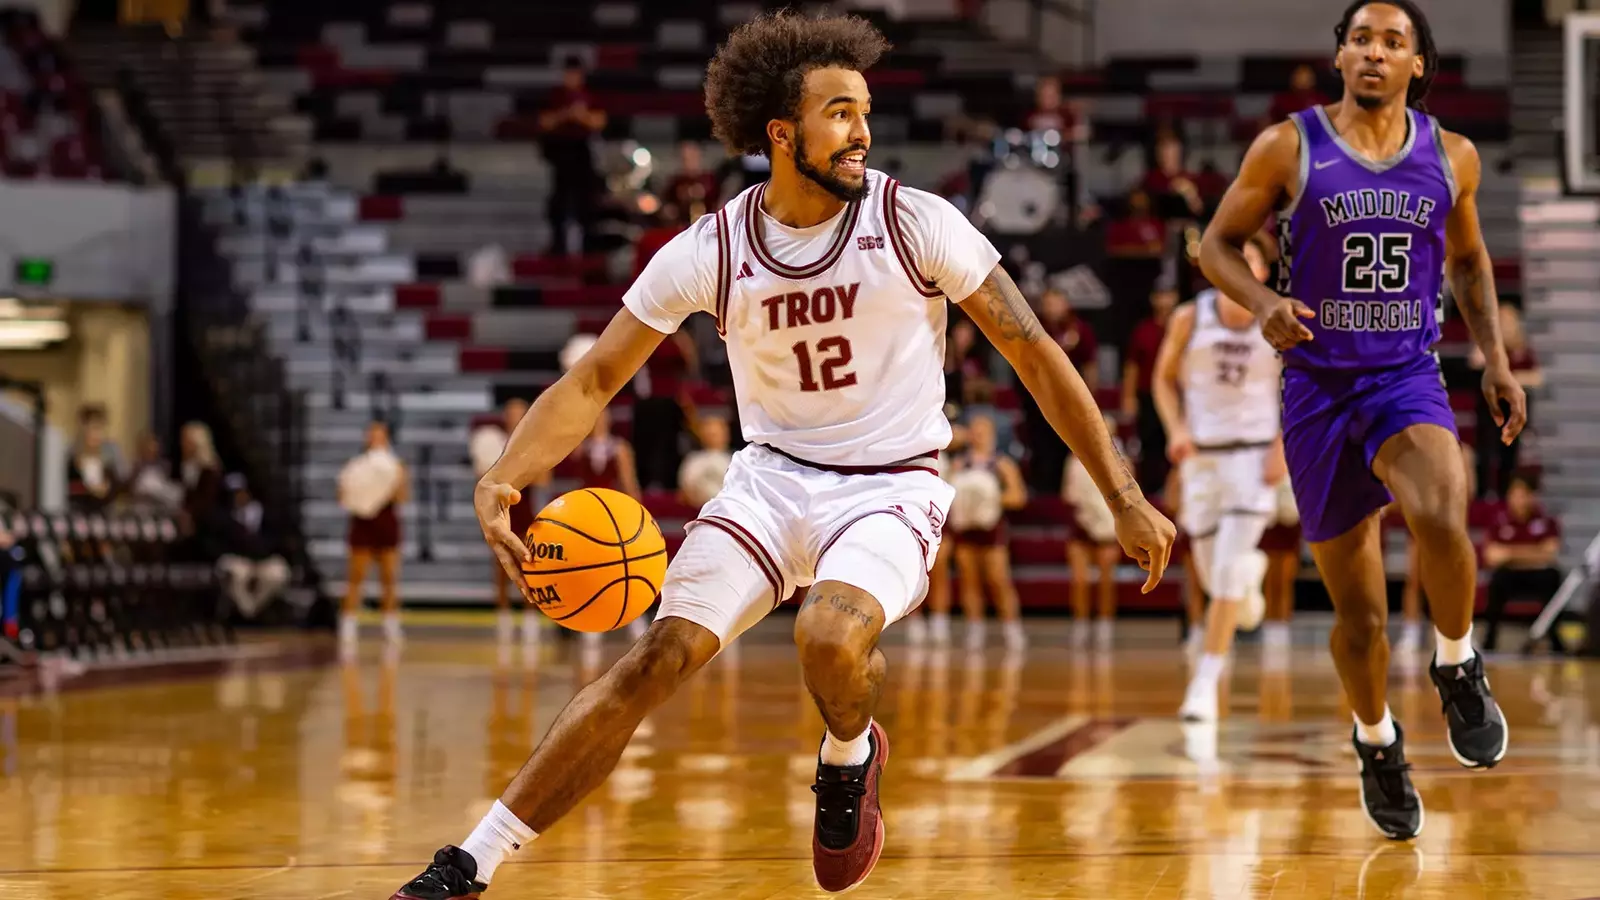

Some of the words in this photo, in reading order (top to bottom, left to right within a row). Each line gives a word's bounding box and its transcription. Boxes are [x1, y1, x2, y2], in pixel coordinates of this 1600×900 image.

[1320, 188, 1436, 228] MIDDLE
[1342, 233, 1412, 292] 25
[761, 281, 861, 331] TROY
[1320, 299, 1421, 331] GEORGIA
[792, 335, 857, 392] 12
